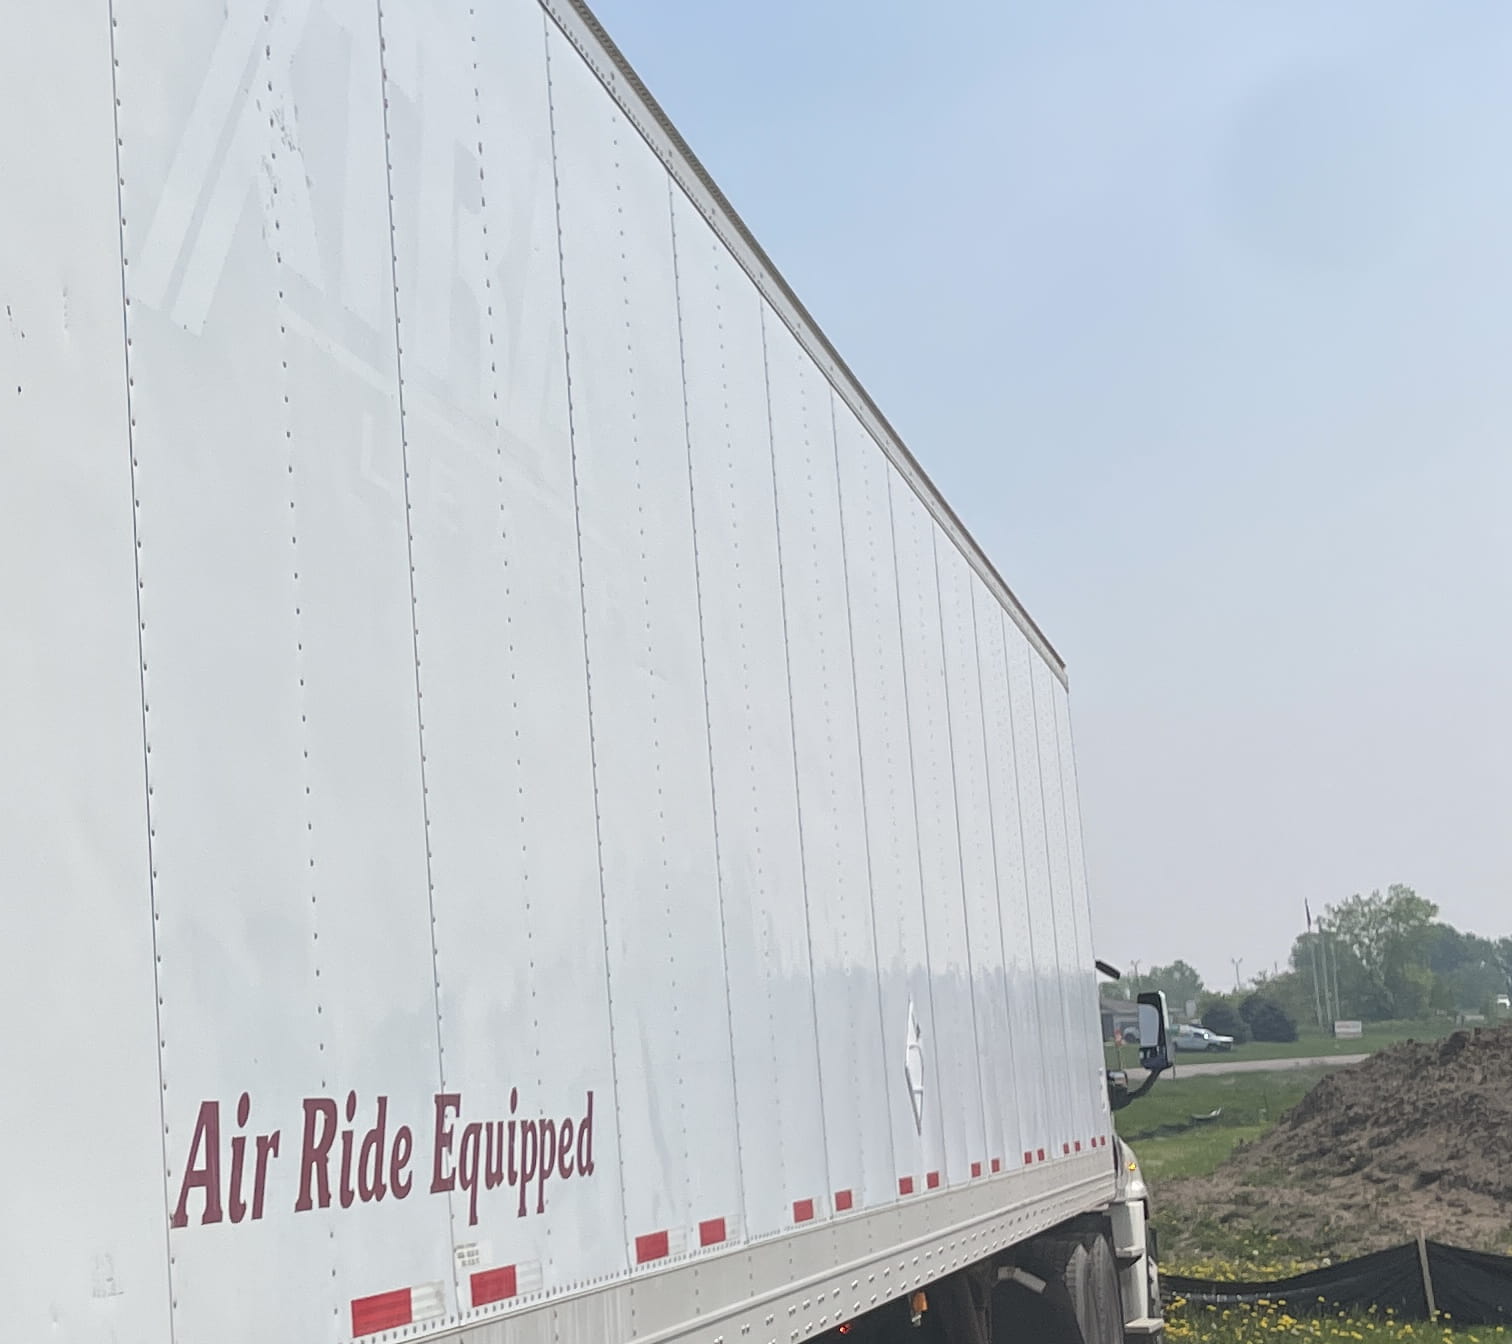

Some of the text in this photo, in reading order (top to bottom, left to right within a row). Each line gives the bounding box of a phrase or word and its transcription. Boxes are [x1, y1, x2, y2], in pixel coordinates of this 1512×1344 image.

[171, 1087, 594, 1229] Air Ride Equipped
